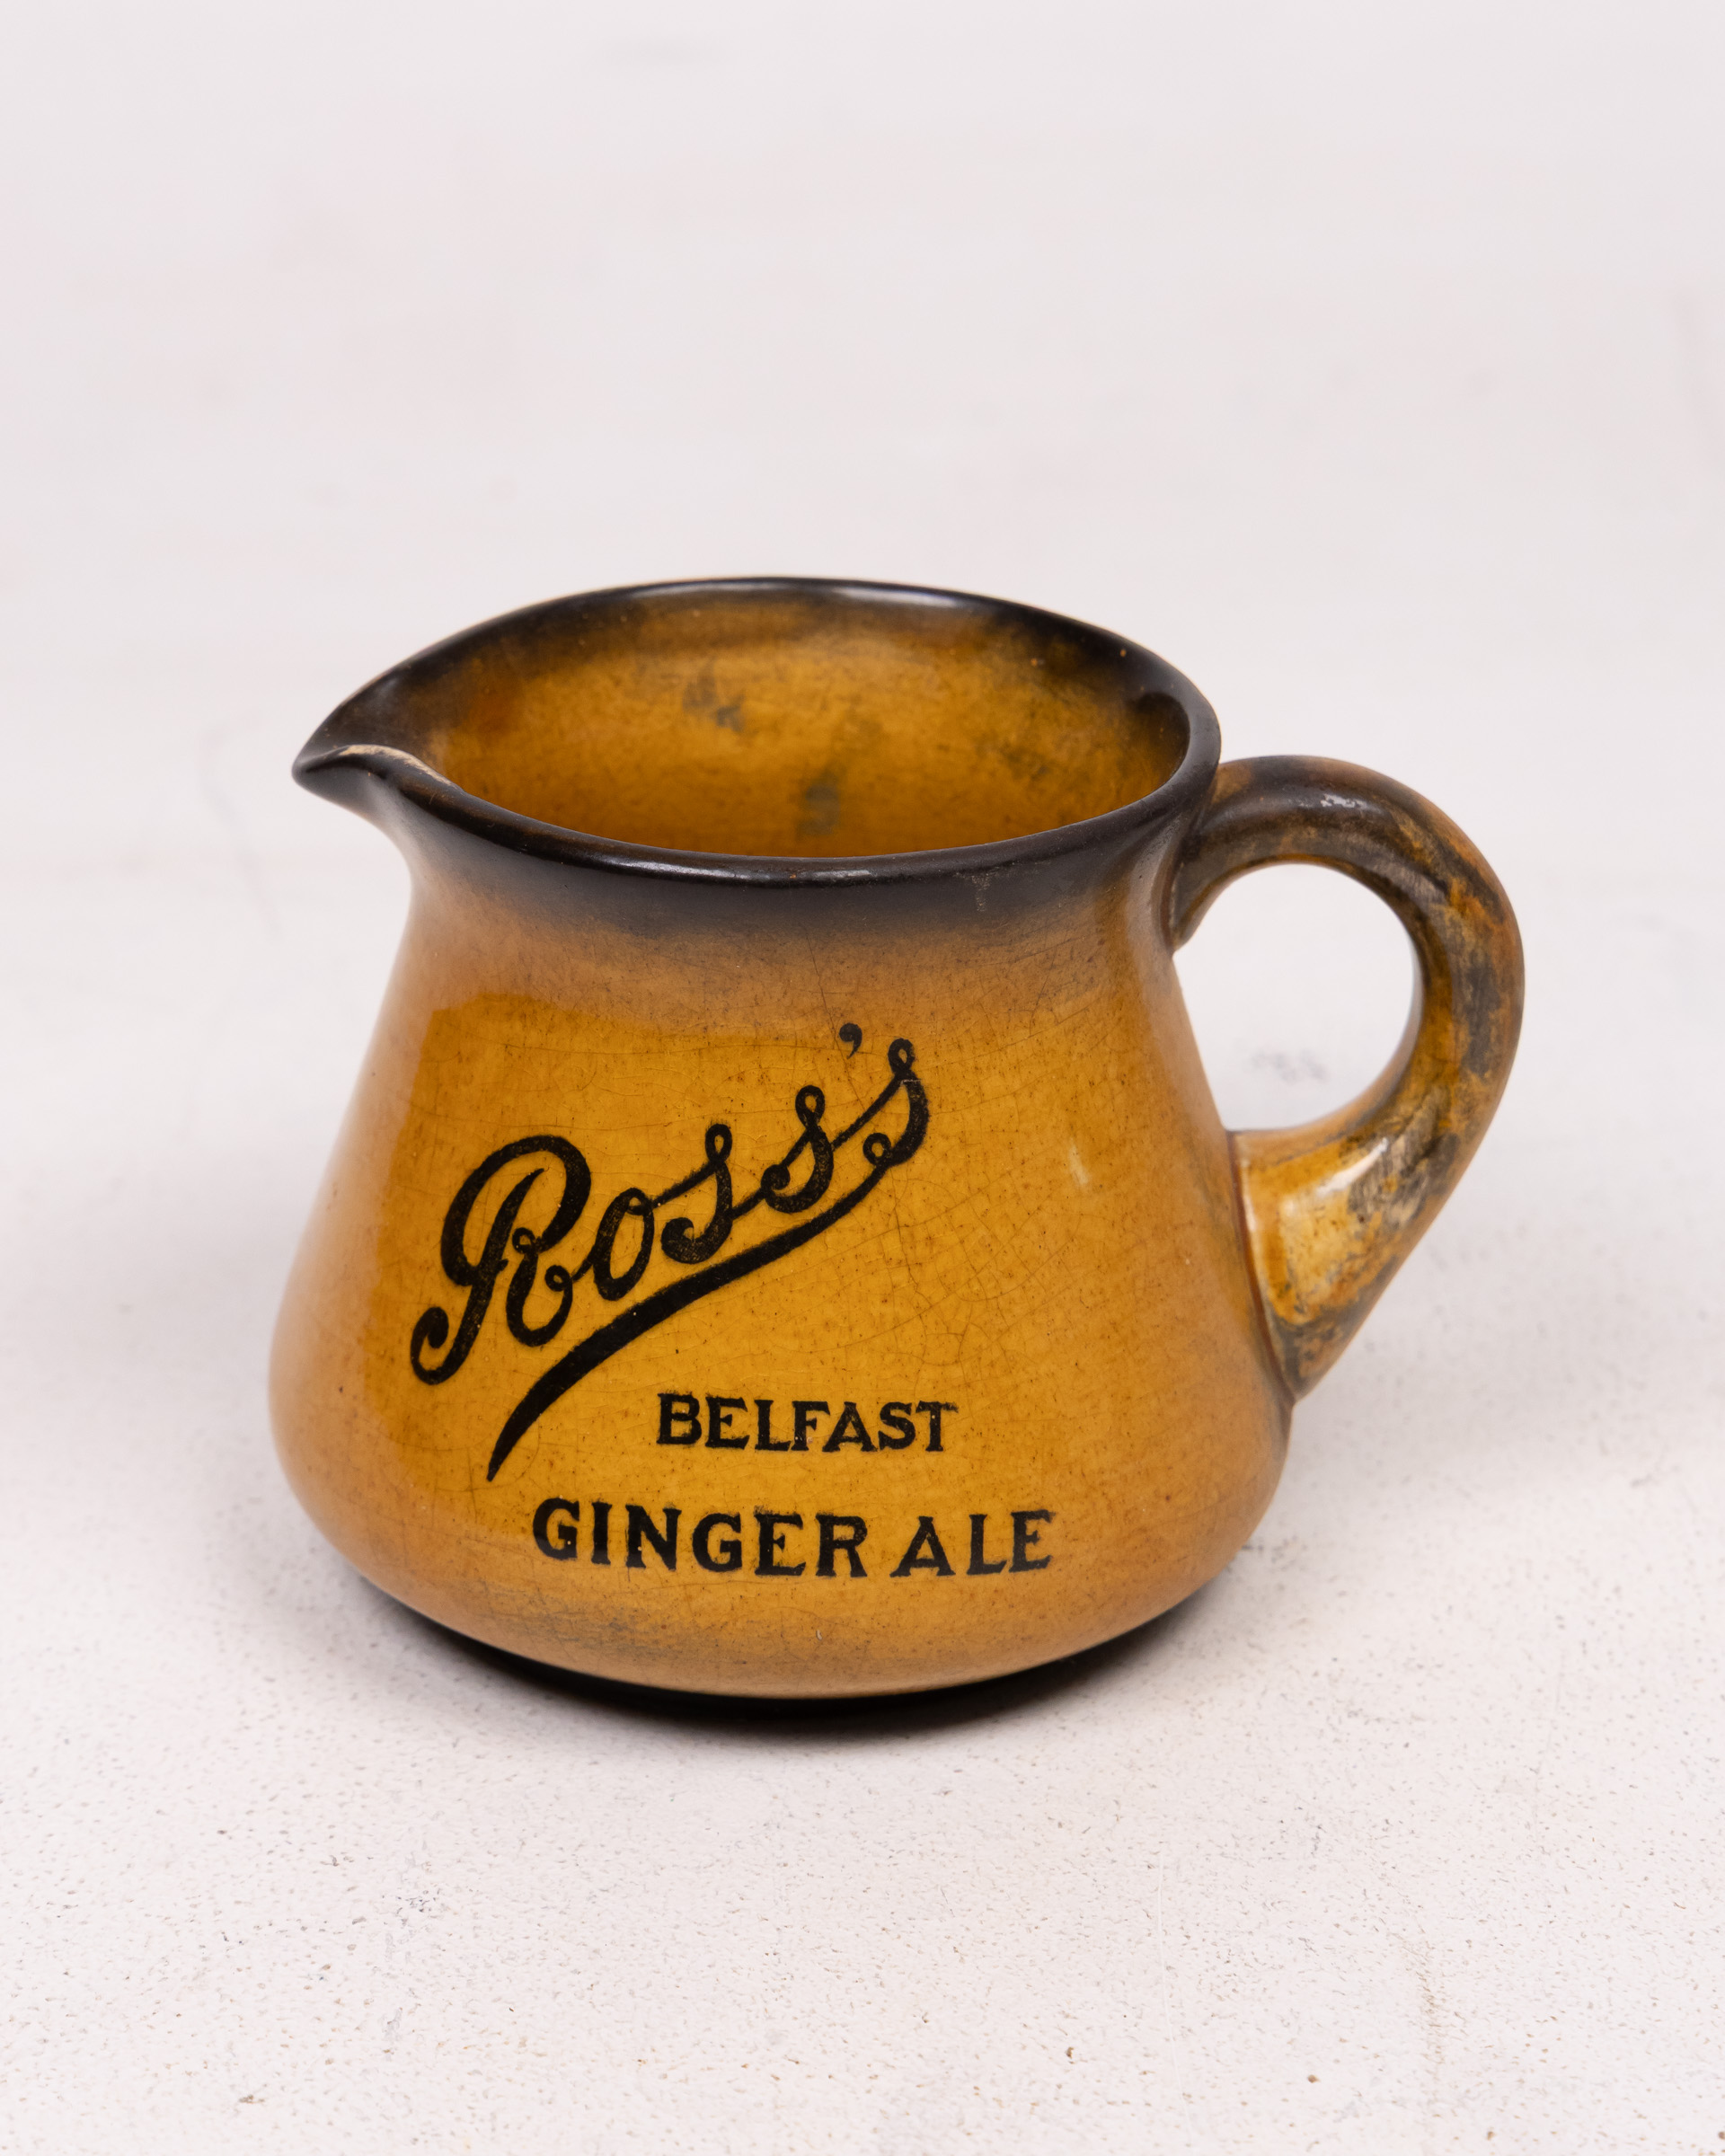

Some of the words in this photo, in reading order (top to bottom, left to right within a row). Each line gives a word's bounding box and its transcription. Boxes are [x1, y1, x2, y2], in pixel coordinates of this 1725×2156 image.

[411, 1022, 930, 1386] Ross's
[656, 1392, 958, 1453] BELFAST
[532, 1497, 868, 1578] GINGER
[889, 1508, 1053, 1578] ALE
